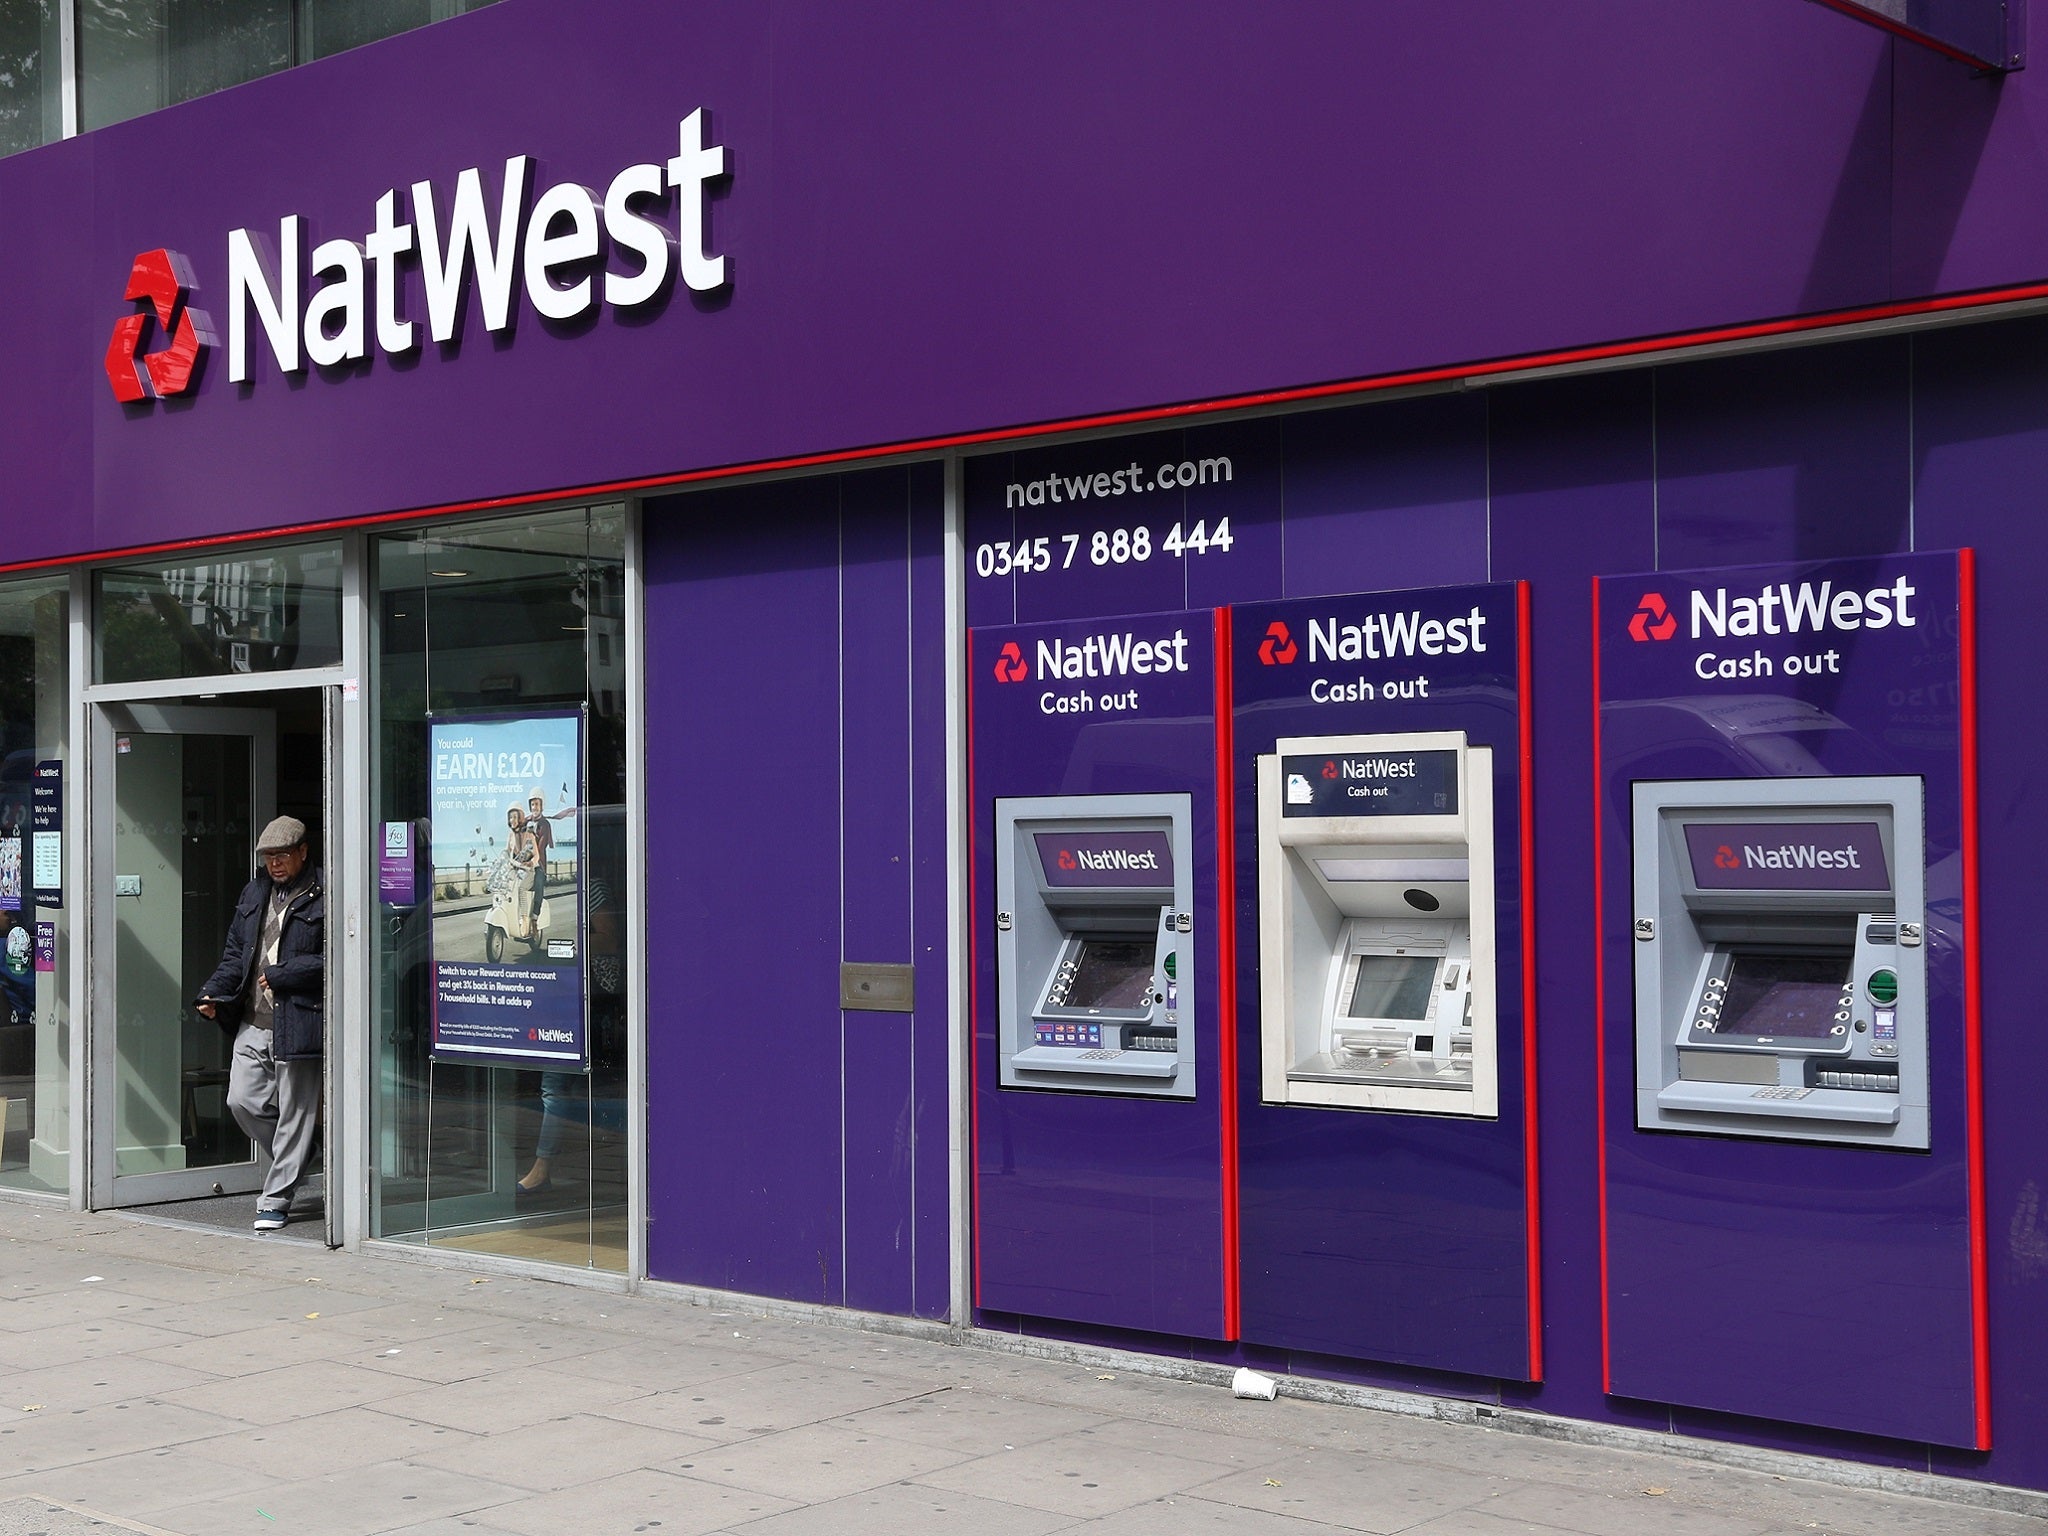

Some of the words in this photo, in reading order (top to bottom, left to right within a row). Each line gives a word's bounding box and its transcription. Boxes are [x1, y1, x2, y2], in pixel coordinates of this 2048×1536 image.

[228, 107, 729, 383] NatWest
[1006, 456, 1233, 509] natwest.com
[976, 537, 1051, 578] 0345
[1061, 534, 1080, 569] 7
[1090, 526, 1152, 566] 888
[1162, 516, 1234, 558] 444
[1691, 575, 1916, 639] NatWest
[1308, 606, 1487, 663] NatWest
[1037, 629, 1189, 681] NatWest
[1695, 650, 1773, 680] Cash
[1783, 649, 1840, 676] out
[1310, 677, 1375, 704] Cash
[1382, 675, 1429, 700] out
[1040, 689, 1093, 715] Cash
[1099, 689, 1139, 711] out
[438, 739, 450, 749] You
[452, 737, 473, 749] could
[436, 752, 493, 780] EARN
[497, 751, 545, 778] £120
[1342, 758, 1416, 779] NatWest
[436, 786, 447, 794] on
[447, 785, 478, 797] average
[479, 783, 487, 793] in
[488, 782, 524, 793] Rewards
[1347, 785, 1370, 797] Cash
[1372, 786, 1389, 797] out
[437, 801, 454, 812] year
[466, 800, 483, 812] year
[484, 799, 497, 808] out
[40, 816, 49, 826] help
[1078, 849, 1159, 871] NatWest
[1744, 845, 1862, 870] NatWest
[37, 925, 53, 936] Free
[37, 938, 53, 948] WiFi
[439, 966, 459, 975] Switch
[480, 967, 504, 977] Reward
[530, 972, 556, 980] account
[439, 979, 450, 988] and
[452, 981, 462, 991] get
[463, 981, 472, 989] 3%
[473, 981, 488, 990] back
[489, 981, 495, 990] in
[497, 982, 524, 992] Rewards
[440, 992, 444, 1001] 7
[444, 992, 475, 1003] household
[497, 996, 505, 1005] all
[506, 996, 522, 1006] adds
[523, 999, 532, 1009] up
[537, 1028, 573, 1043] NatWest
